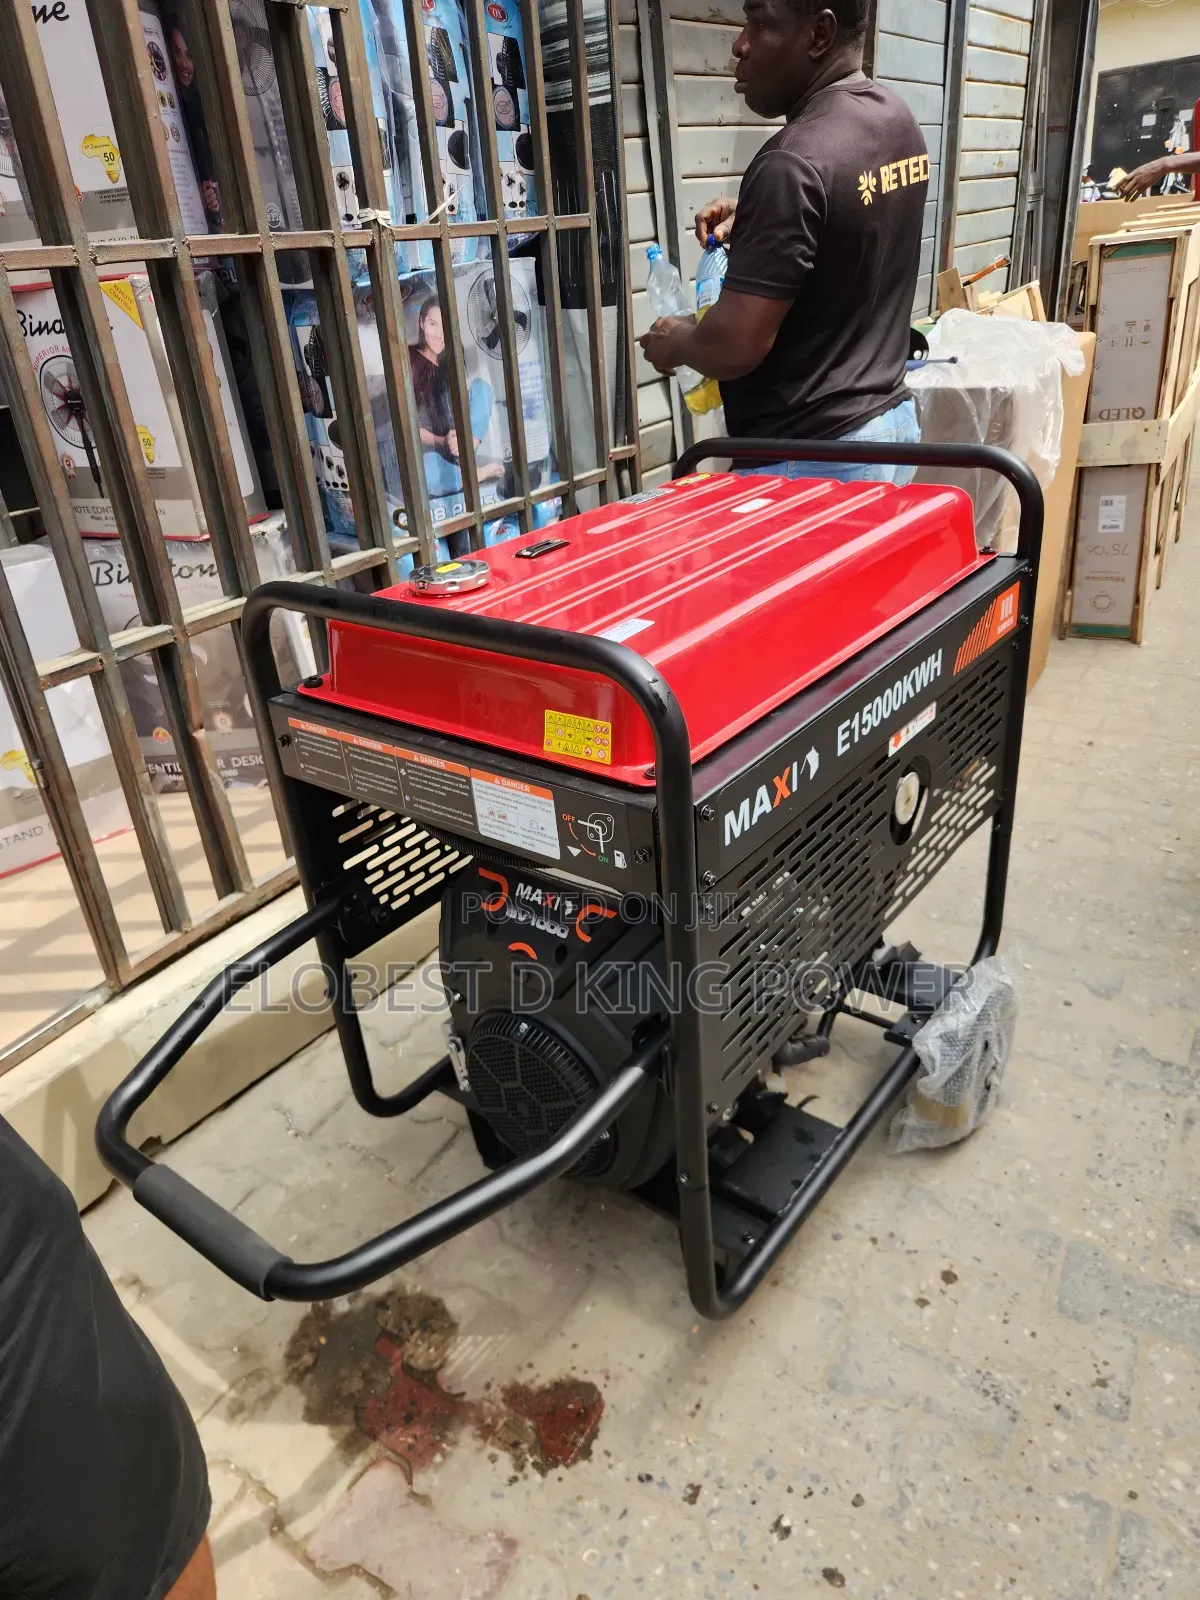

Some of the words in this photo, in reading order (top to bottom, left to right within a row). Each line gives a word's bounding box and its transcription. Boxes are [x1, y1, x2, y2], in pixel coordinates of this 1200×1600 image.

[103, 151, 115, 162] 50
[109, 288, 133, 313] CONTROL
[113, 284, 133, 304] REMOTE
[33, 345, 60, 373] SUPERIOR
[1098, 406, 1146, 421] QLED
[724, 760, 798, 847] MAXI
[836, 647, 943, 757] E15000KWH
[420, 755, 446, 769] DANGER
[501, 778, 531, 793] DANGER
[562, 813, 576, 823] OFF
[597, 854, 609, 864] ON
[515, 882, 561, 911] MAXI
